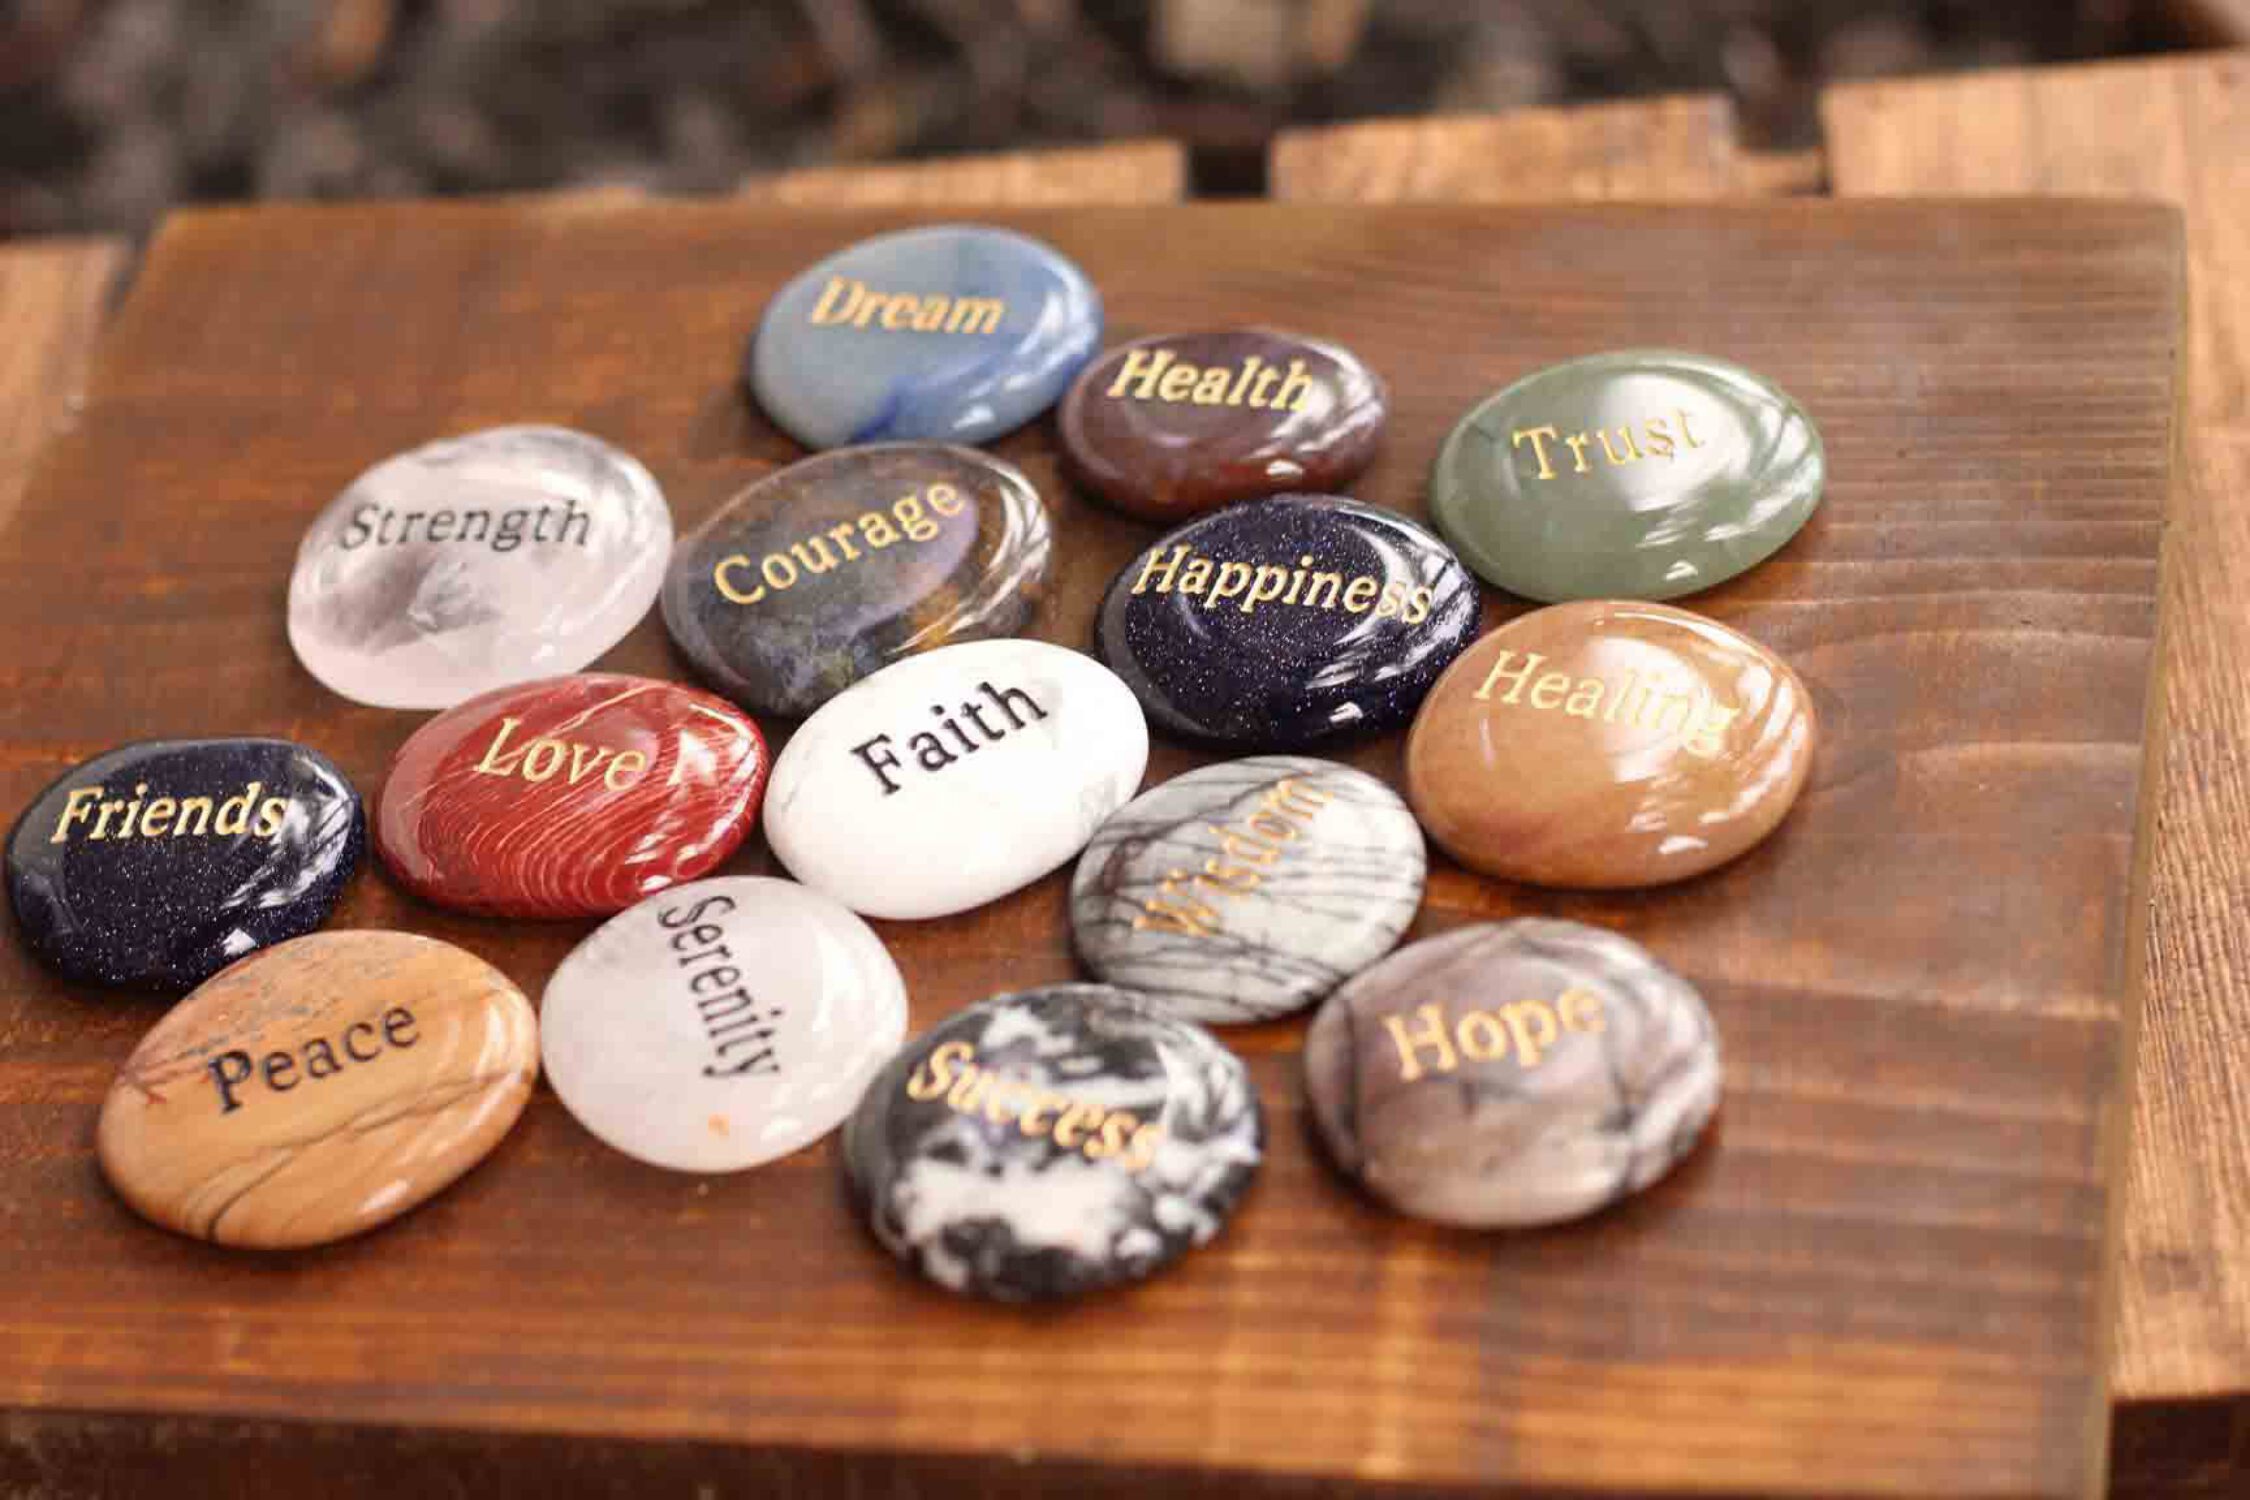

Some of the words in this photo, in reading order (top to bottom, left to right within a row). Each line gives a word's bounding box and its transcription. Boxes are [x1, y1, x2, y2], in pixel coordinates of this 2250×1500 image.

[810, 277, 1003, 335] Dream
[1106, 350, 1314, 411] Health
[1512, 406, 1706, 480] Trust
[341, 498, 590, 551] Strength
[713, 478, 966, 606] Courage
[1131, 545, 1434, 625] Happiness
[851, 680, 1048, 793] Faith
[1475, 650, 1737, 756] Healing
[474, 718, 645, 792] Love
[52, 783, 287, 842] Friends
[1134, 773, 1333, 937] Wisdom
[657, 895, 781, 1077] Serenity
[1385, 986, 1606, 1080] Hope
[209, 1004, 418, 1110] Peace
[907, 1040, 1161, 1173] Success
